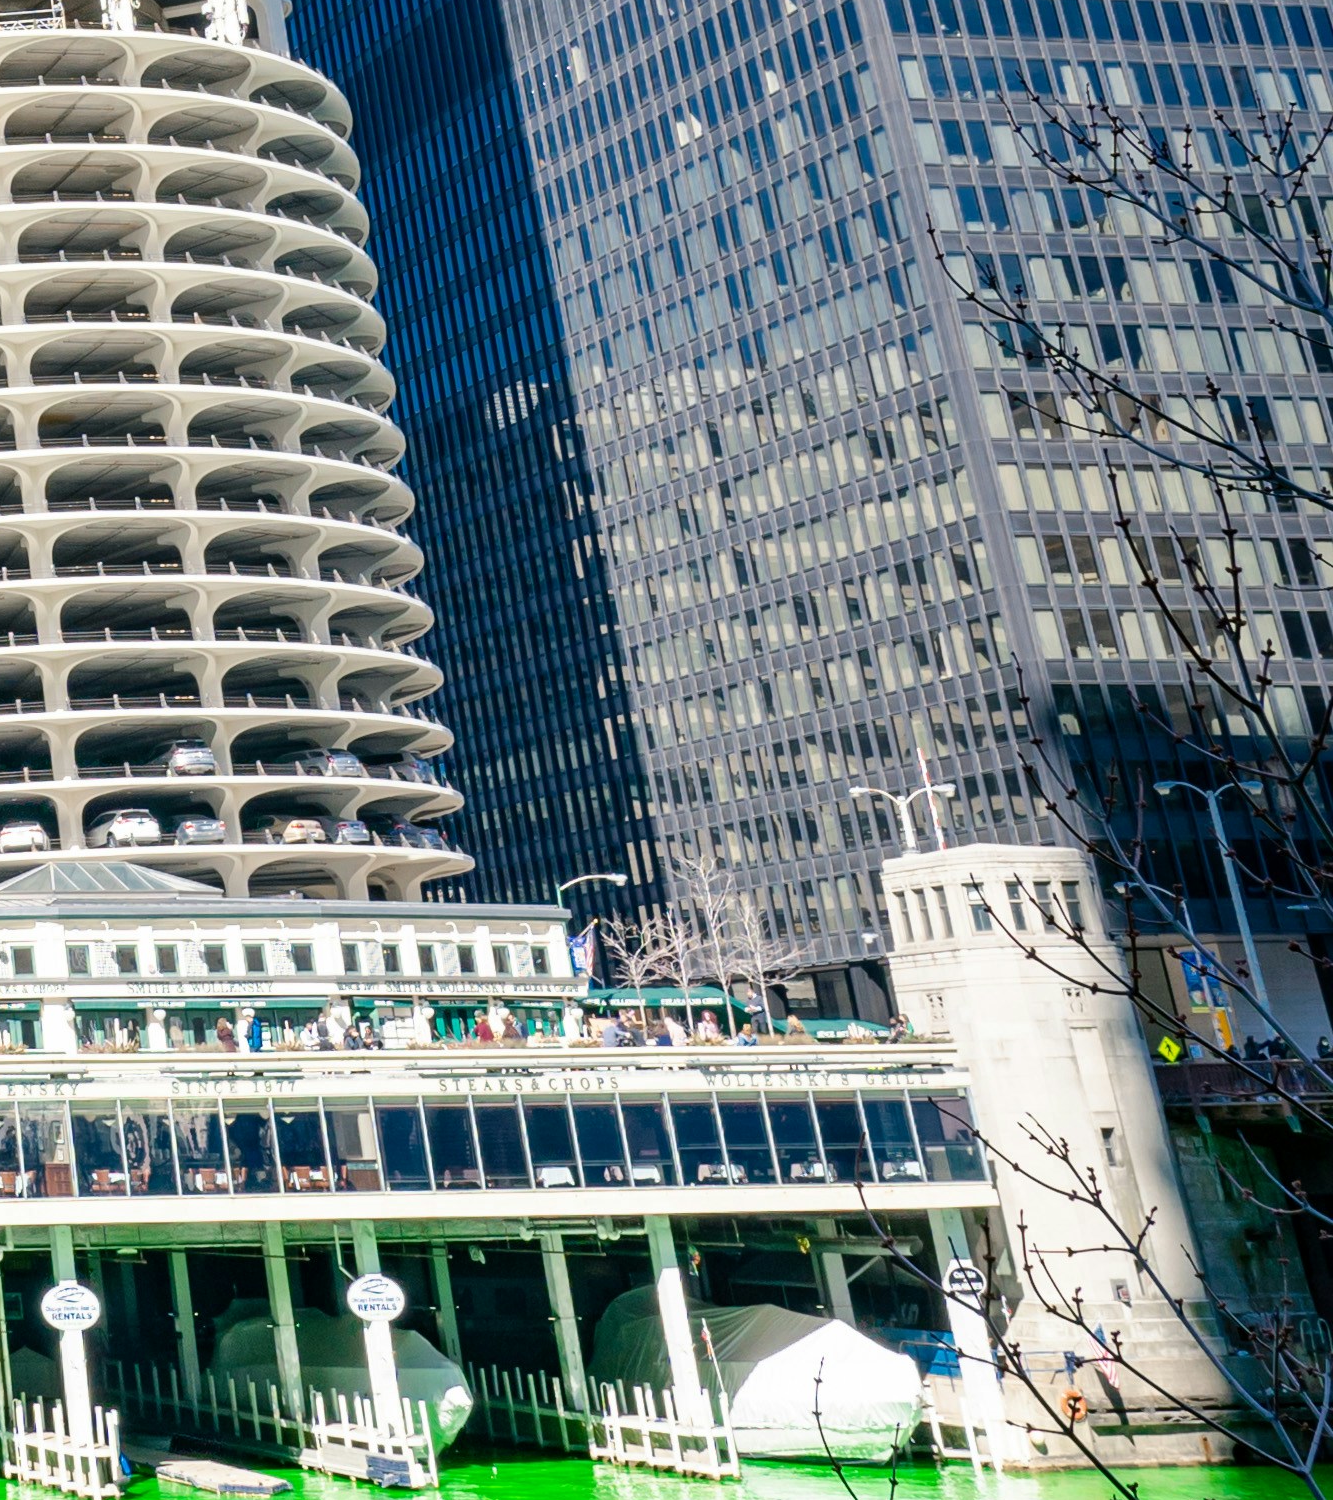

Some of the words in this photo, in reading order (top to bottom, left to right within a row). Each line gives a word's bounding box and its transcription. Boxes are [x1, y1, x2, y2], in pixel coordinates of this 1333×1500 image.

[127, 982, 171, 994] SMITH
[176, 982, 185, 993] &
[190, 981, 274, 993] WOLLENSKY
[384, 981, 421, 992] SMITH
[440, 981, 506, 993] WOLLENSKY
[172, 1081, 238, 1094] SINCE
[254, 1080, 296, 1093] 1977
[439, 1078, 523, 1092] STEAKS
[531, 1078, 541, 1091] &
[548, 1077, 619, 1091] CHOPS
[705, 1073, 850, 1087] WOLLENSKY'S
[866, 1073, 929, 1085] GRILL
